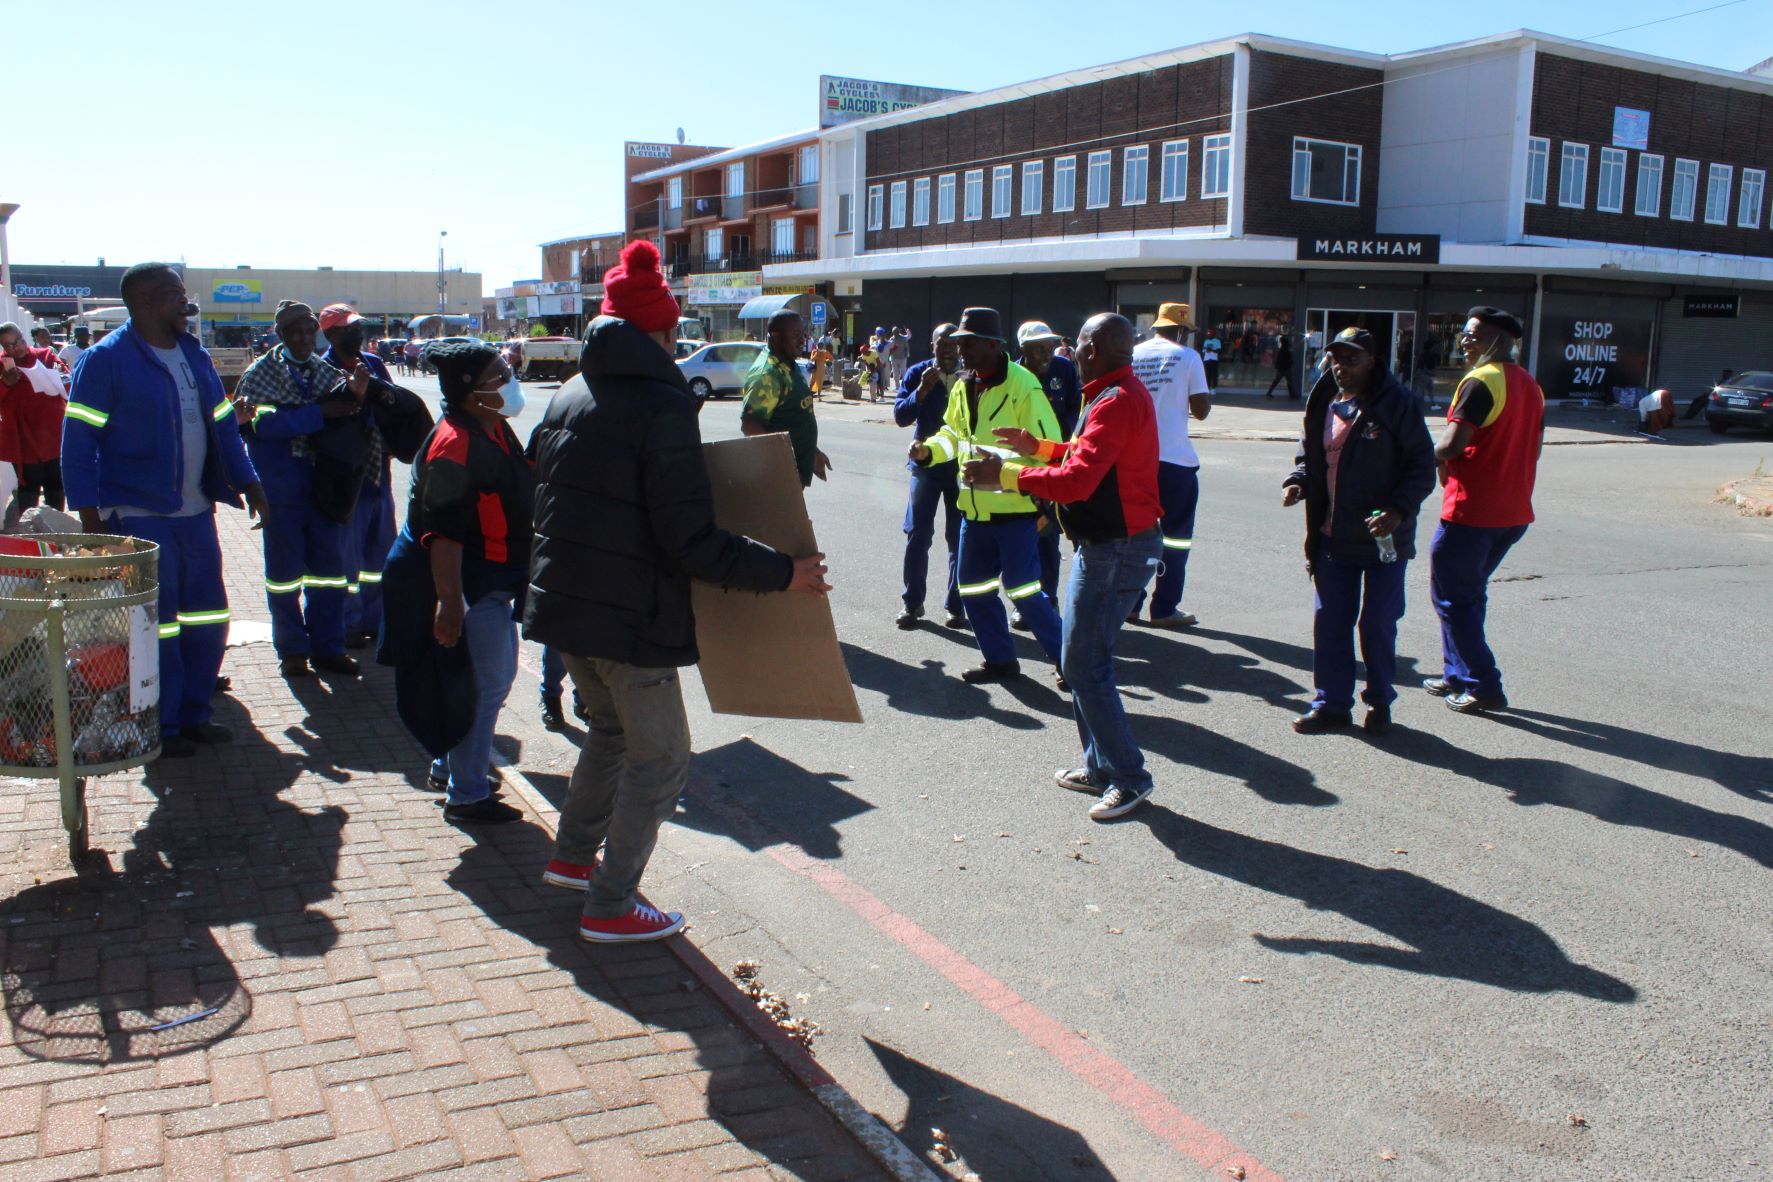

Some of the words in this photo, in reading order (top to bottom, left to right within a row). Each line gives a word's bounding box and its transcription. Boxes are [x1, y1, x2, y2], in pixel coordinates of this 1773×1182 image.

[837, 80, 878, 91] JACOB'S
[839, 90, 876, 98] CYCLES
[840, 98, 888, 113] JACOB'S
[1315, 240, 1421, 256] MARKHAM
[15, 283, 91, 296] Furniture
[814, 304, 822, 315] P
[1574, 321, 1613, 339] SHOP
[1565, 344, 1618, 362] ONLINE
[1573, 365, 1606, 386] 24/7
